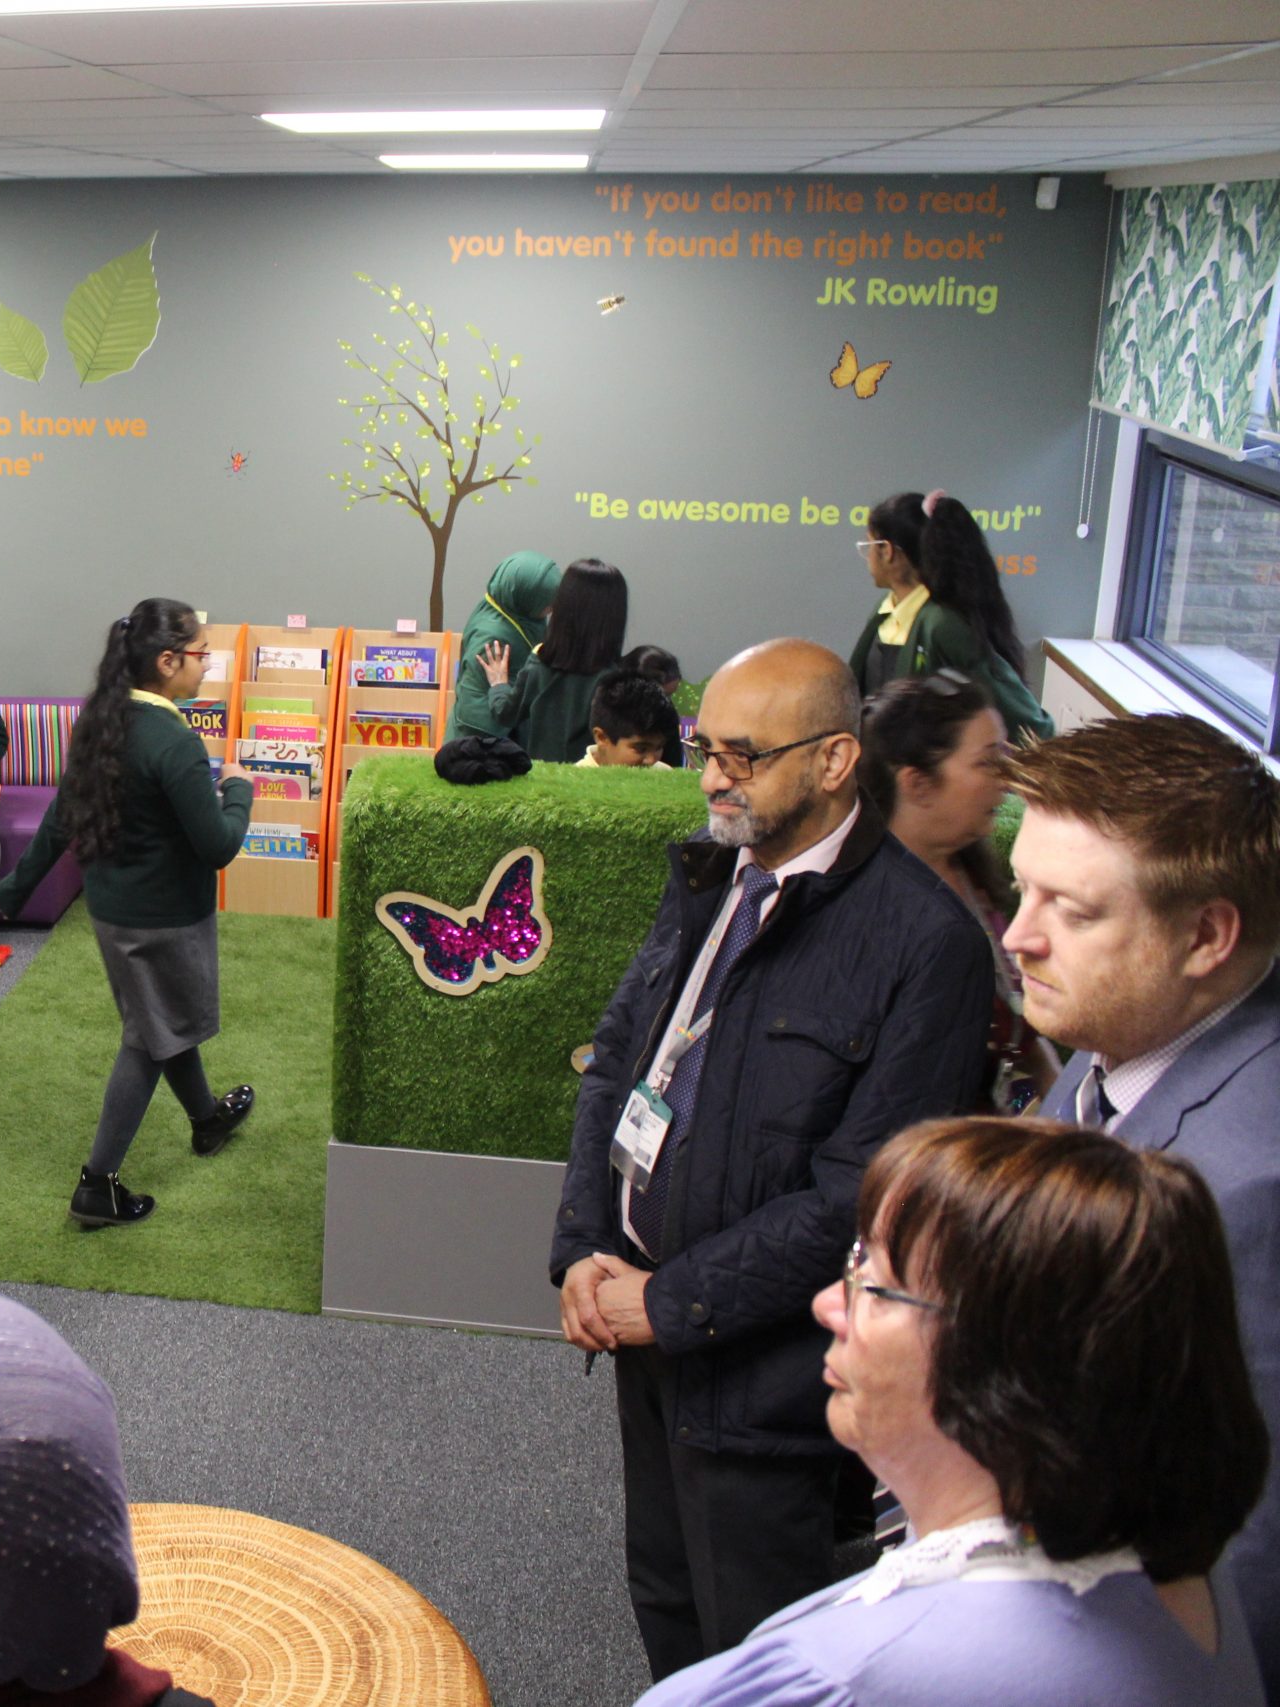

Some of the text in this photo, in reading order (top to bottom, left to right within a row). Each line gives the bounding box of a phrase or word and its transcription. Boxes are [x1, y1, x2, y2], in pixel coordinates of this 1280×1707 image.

[595, 184, 1006, 220] "If you don't like to read,
[448, 228, 1002, 267] you haven't found the right book"
[817, 276, 998, 314] JK Rowling
[20, 411, 97, 436] know
[105, 418, 147, 437] we
[576, 492, 629, 519] "Be
[638, 499, 790, 523] awesome
[800, 497, 840, 525] be
[380, 648, 396, 656] WHAT
[397, 649, 417, 657] ABOUT
[356, 724, 422, 748] YOU
[260, 782, 286, 793] LOVE
